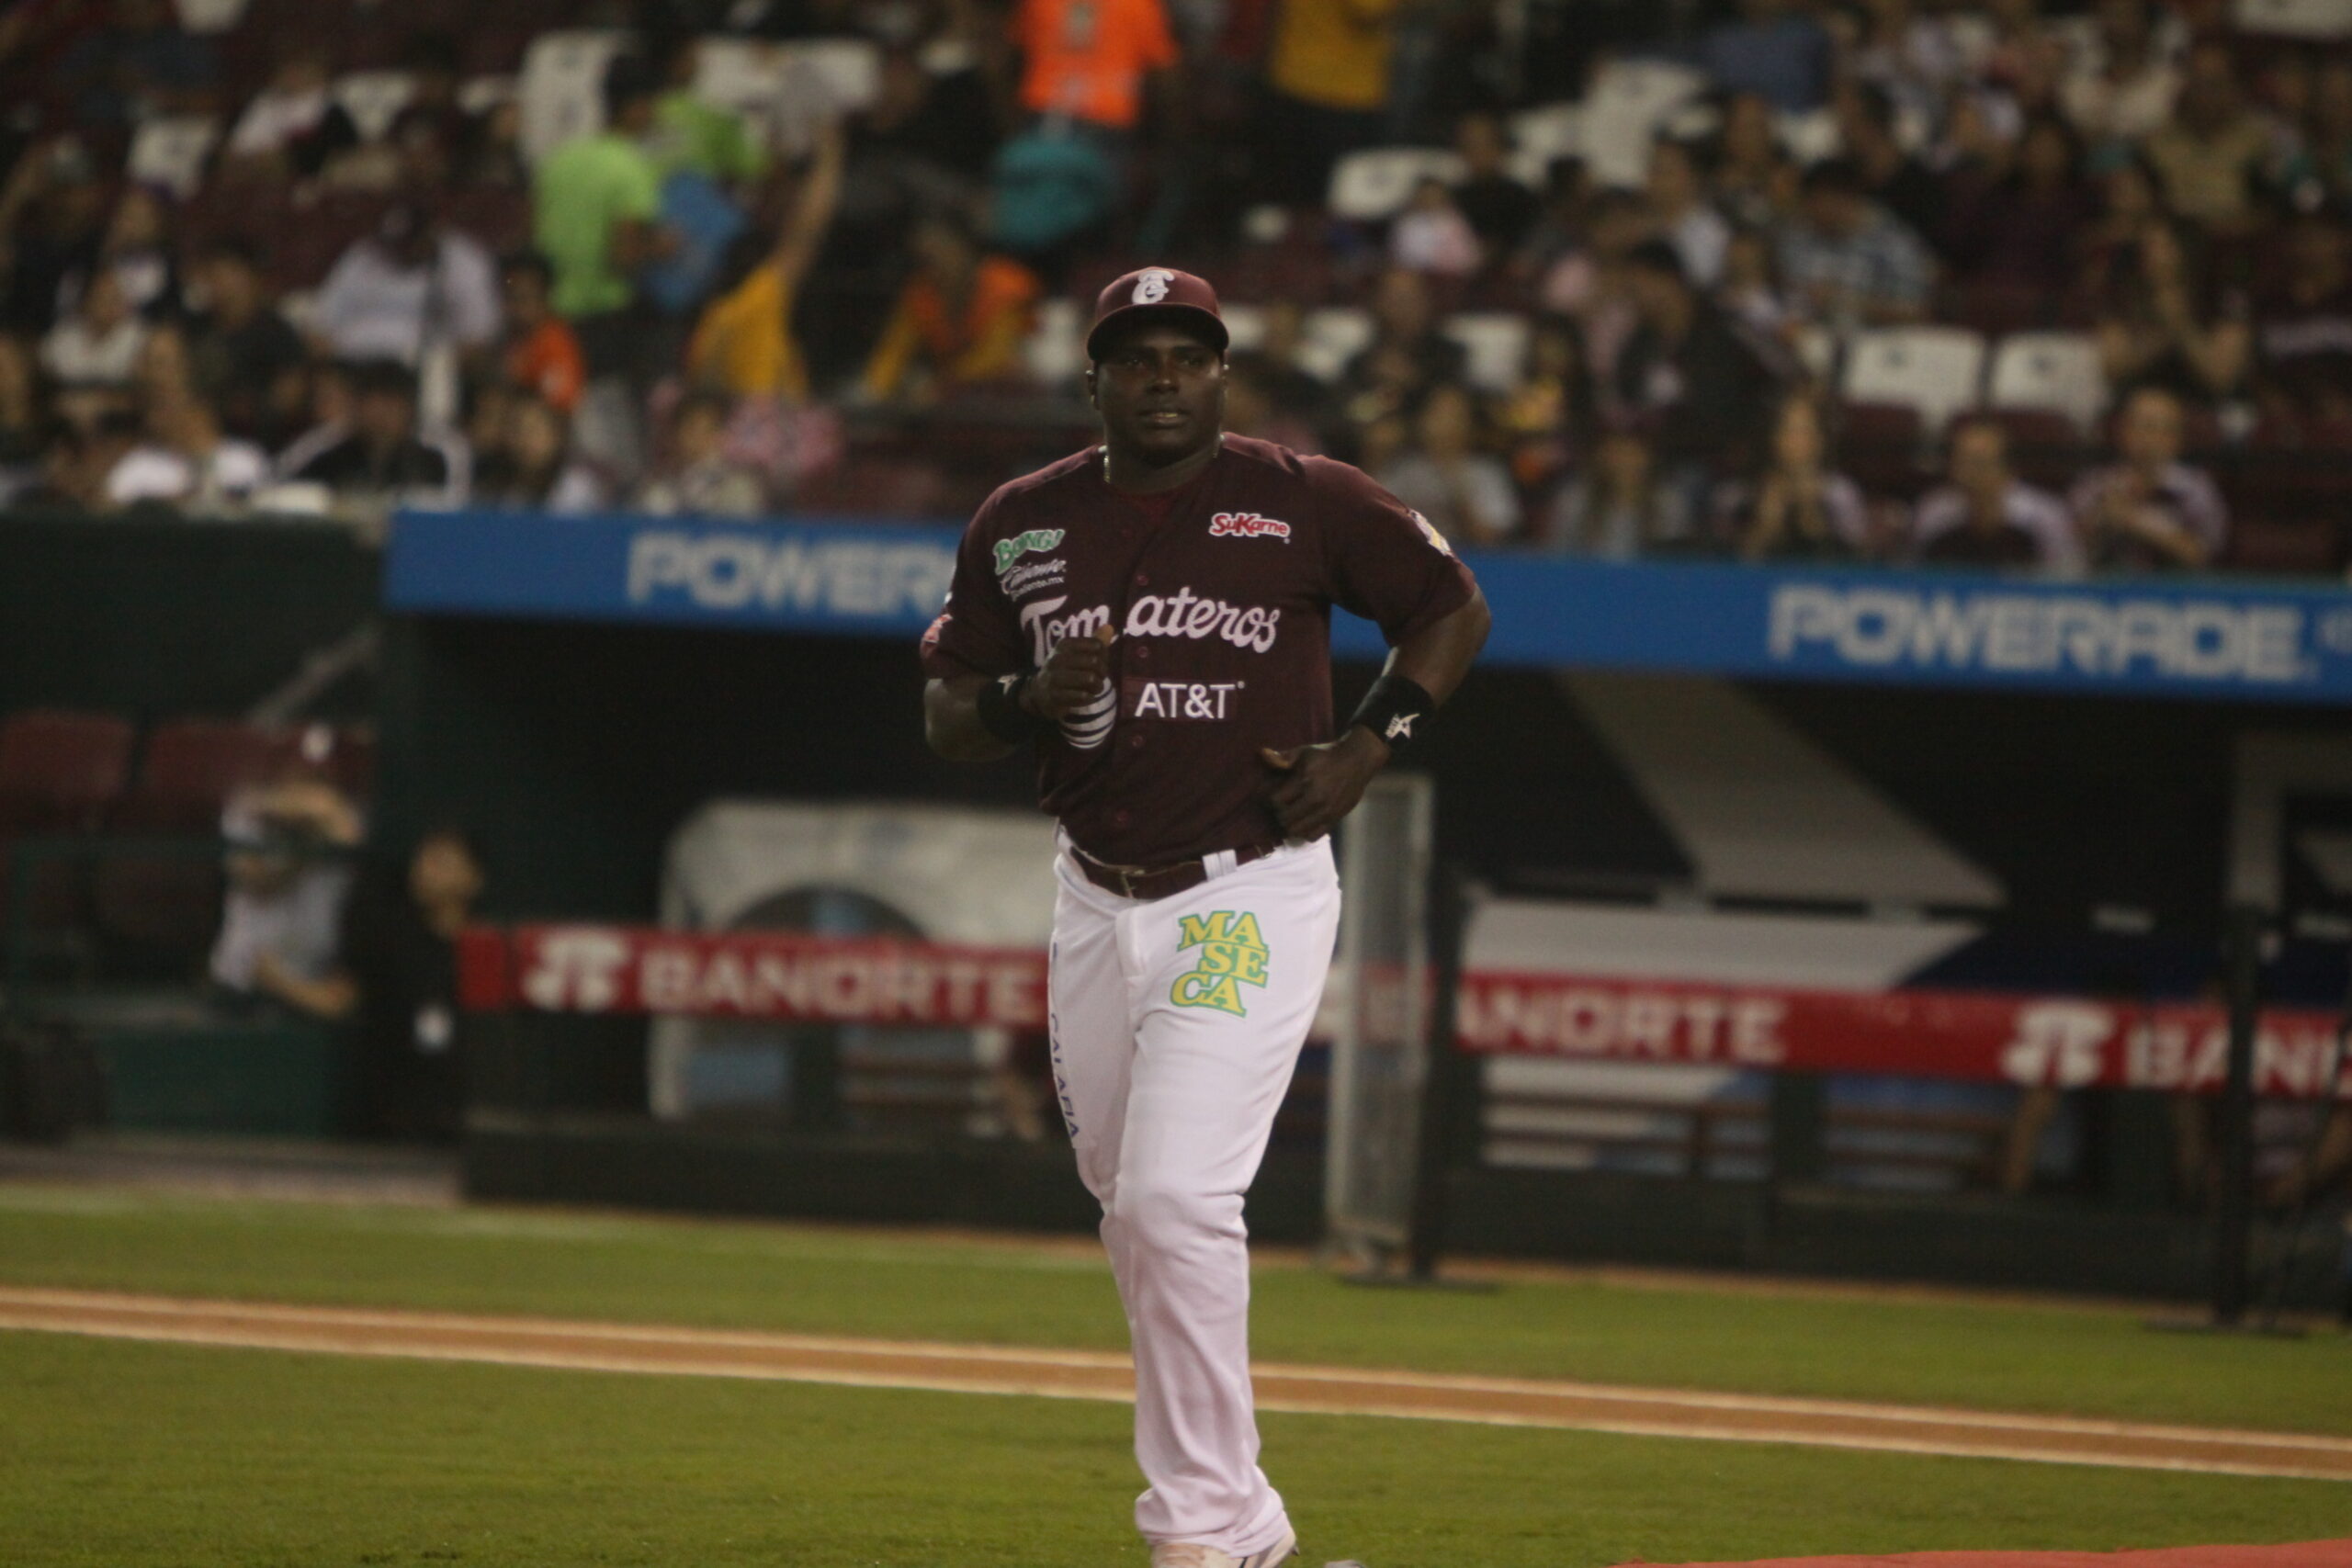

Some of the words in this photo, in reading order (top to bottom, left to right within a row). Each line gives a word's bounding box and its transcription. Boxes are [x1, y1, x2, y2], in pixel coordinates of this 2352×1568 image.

[1209, 513, 1291, 537] SuKarne
[628, 533, 958, 614] POWER
[1768, 584, 2304, 683] POWERADE
[1135, 682, 1236, 719] AT&T
[639, 946, 1038, 1023] BANORTE
